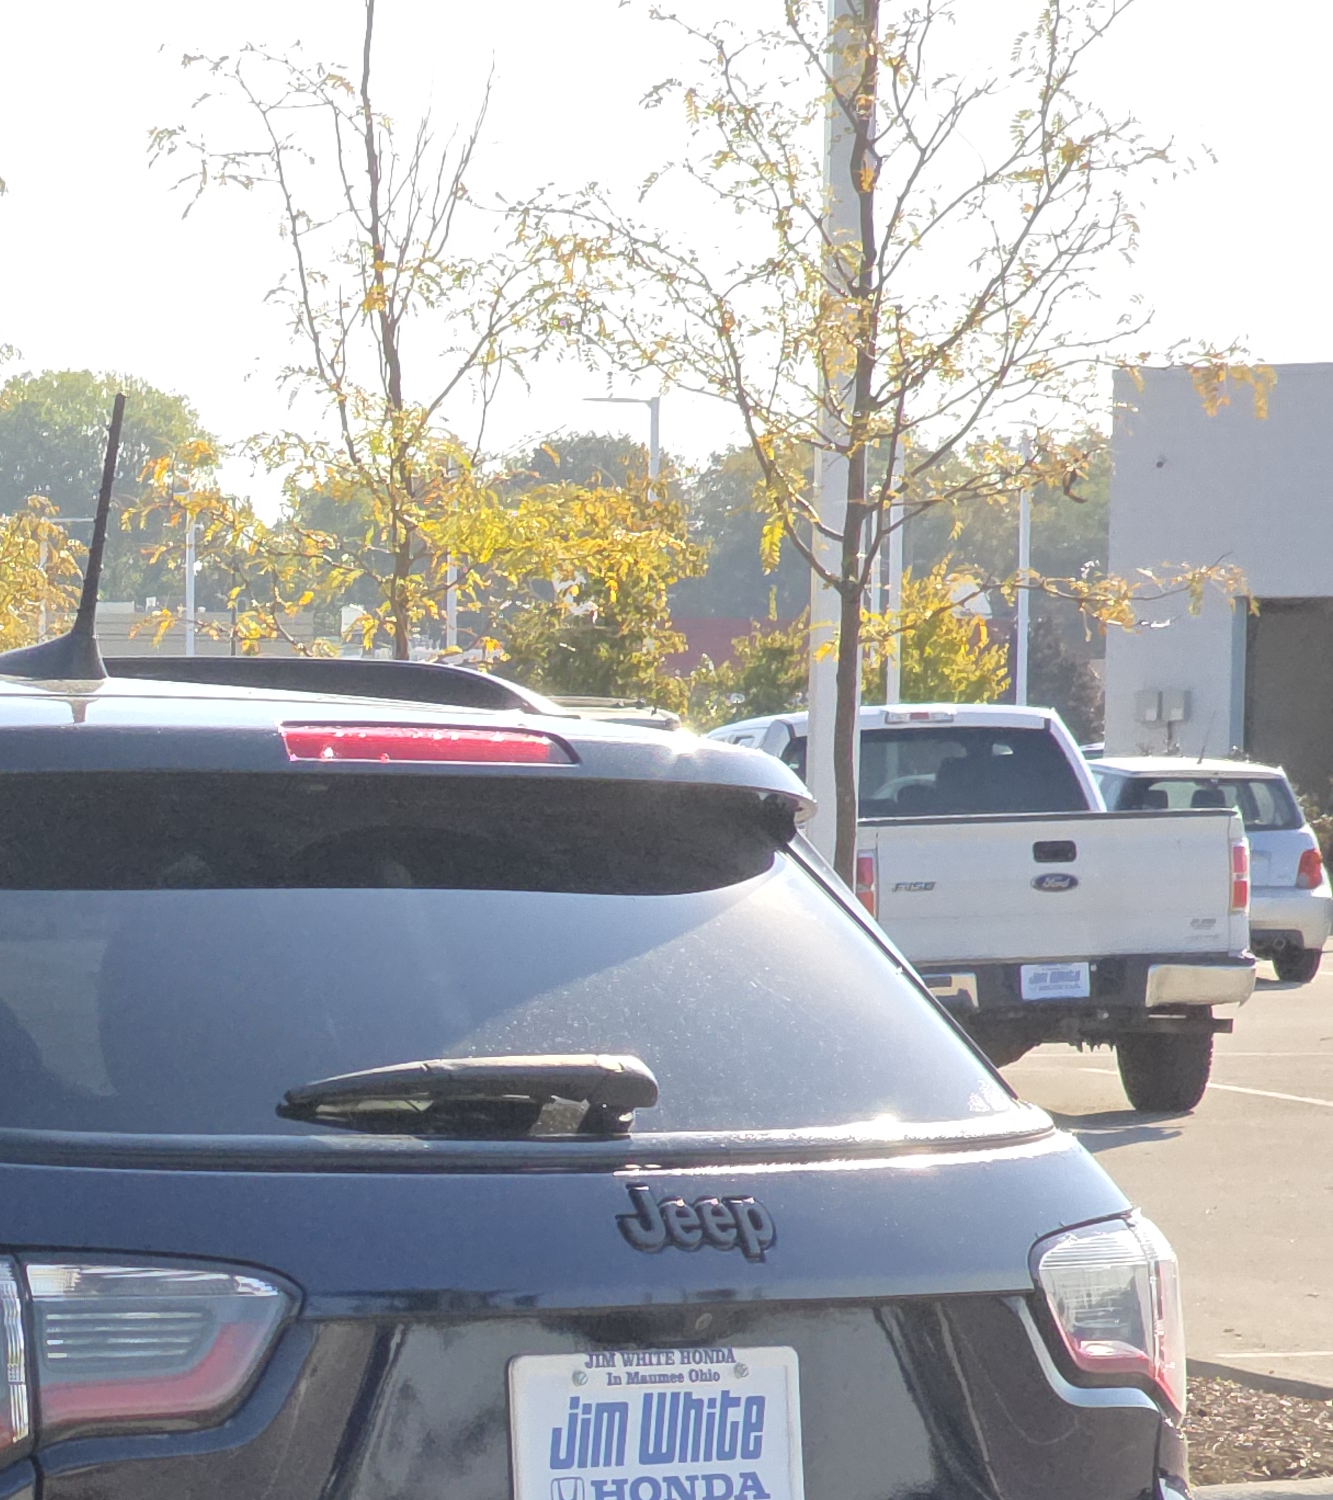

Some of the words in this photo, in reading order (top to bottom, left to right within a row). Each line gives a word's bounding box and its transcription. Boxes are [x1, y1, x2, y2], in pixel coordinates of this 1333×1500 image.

[615, 1182, 776, 1263] Jeep
[584, 1352, 617, 1369] JIM
[621, 1350, 676, 1367] WHITE
[680, 1347, 736, 1365] HONDA
[606, 1371, 623, 1386] In
[626, 1370, 685, 1385] Maumee
[688, 1368, 721, 1383] Ohio
